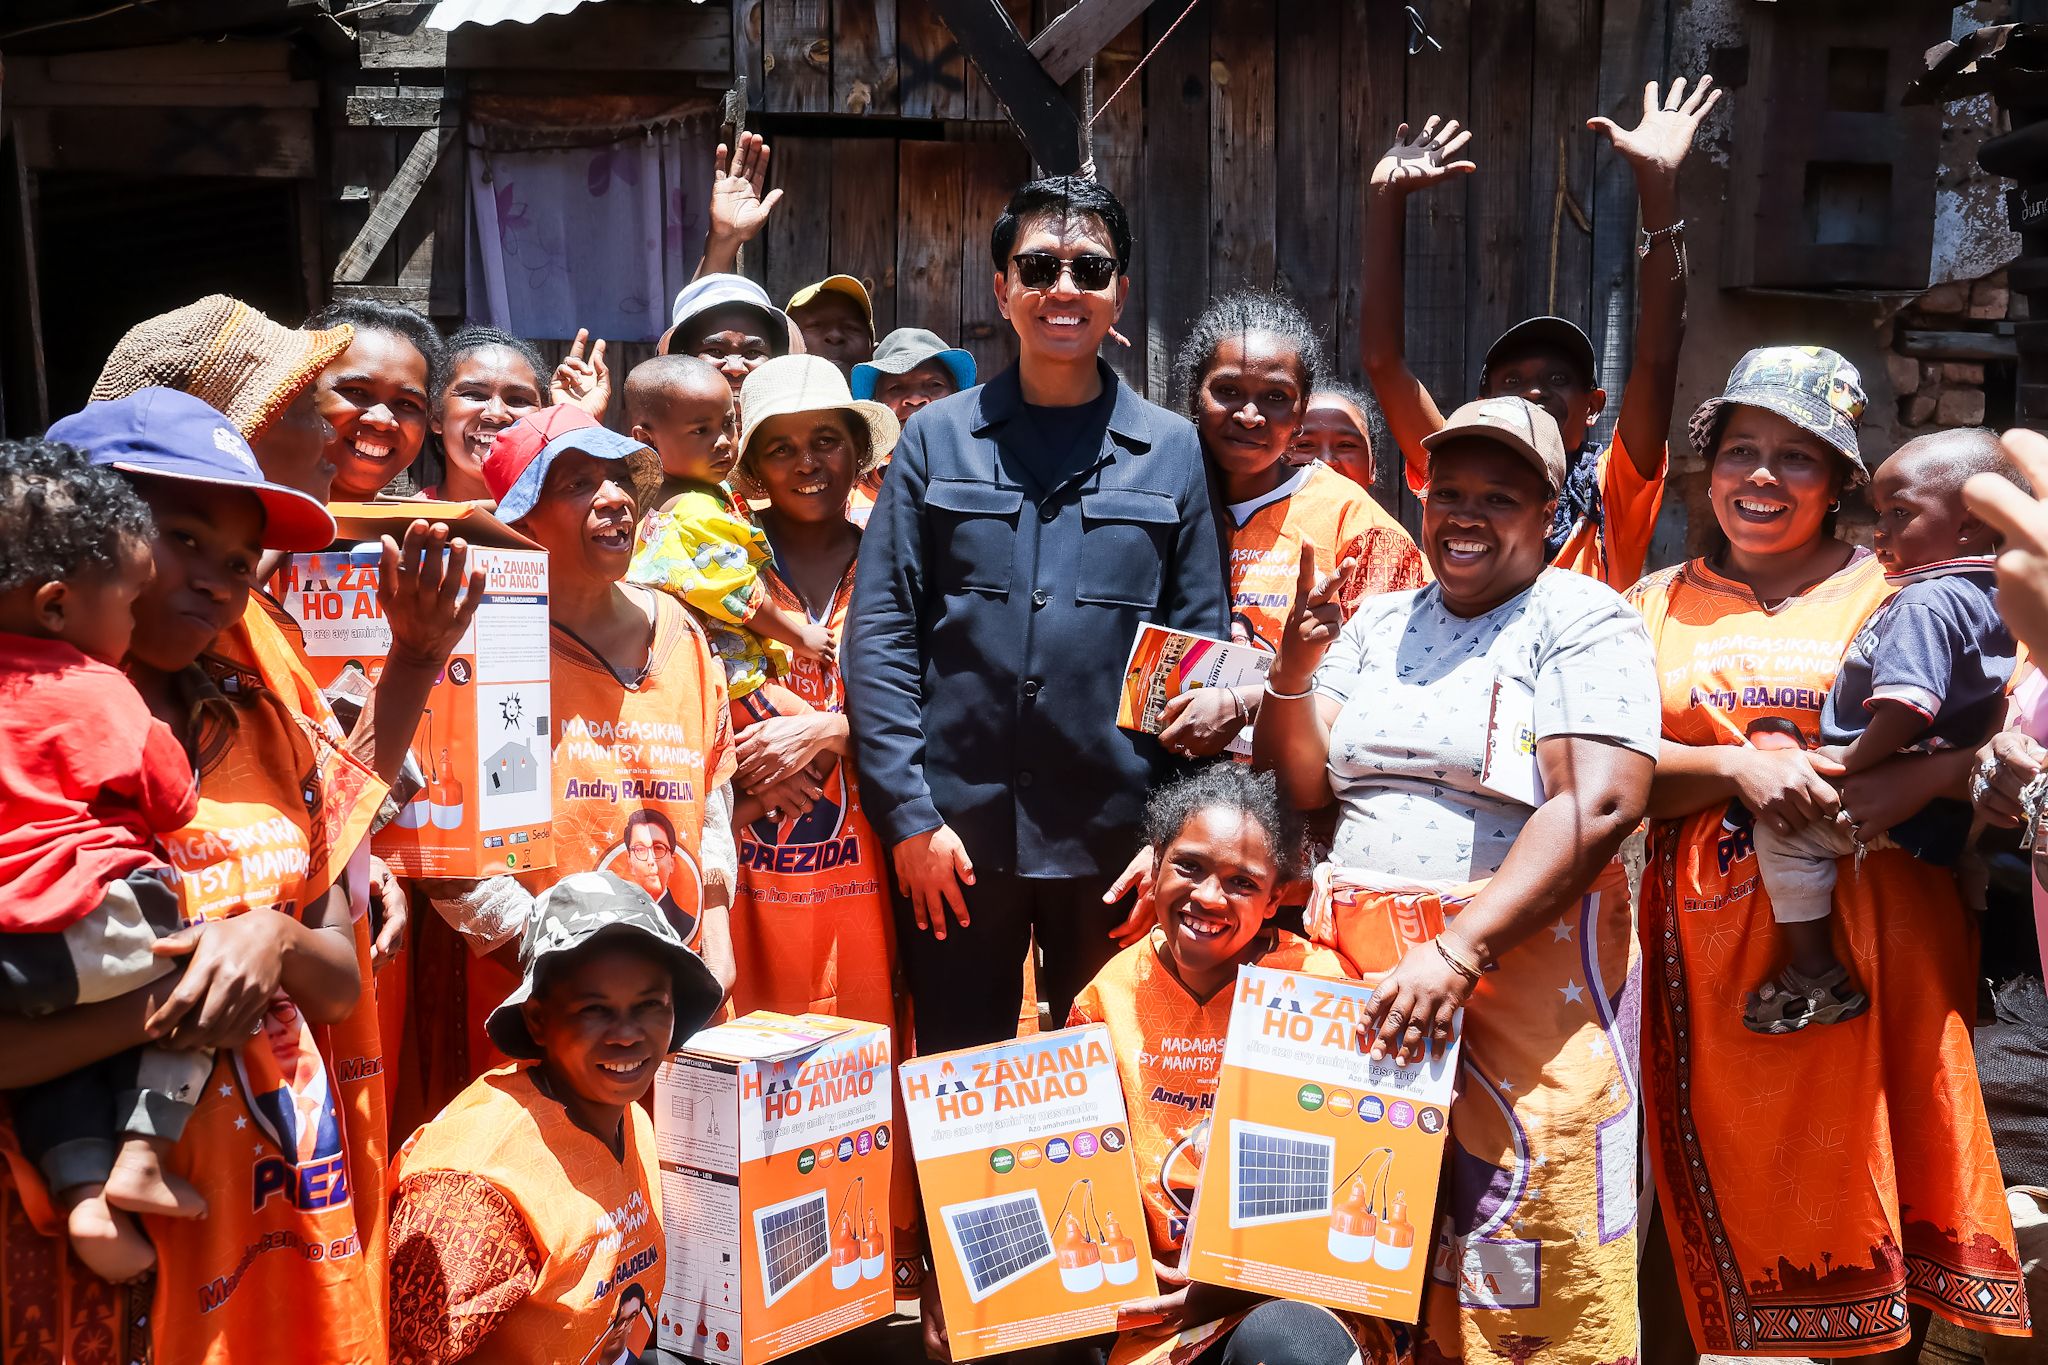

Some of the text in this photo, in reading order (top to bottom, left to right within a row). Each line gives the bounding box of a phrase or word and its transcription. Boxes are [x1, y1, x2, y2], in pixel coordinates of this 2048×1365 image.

[490, 574, 539, 589] HO ANAO
[303, 592, 343, 620] HO
[565, 778, 618, 803] Andry
[1263, 1010, 1314, 1042] HO
[906, 1040, 1110, 1101] HAZAVANA
[1162, 1055, 1217, 1072] MAINTSY
[765, 1070, 873, 1122] HO ANAO
[936, 1070, 1088, 1122] HO ANAO
[1151, 1086, 1199, 1112] Andry
